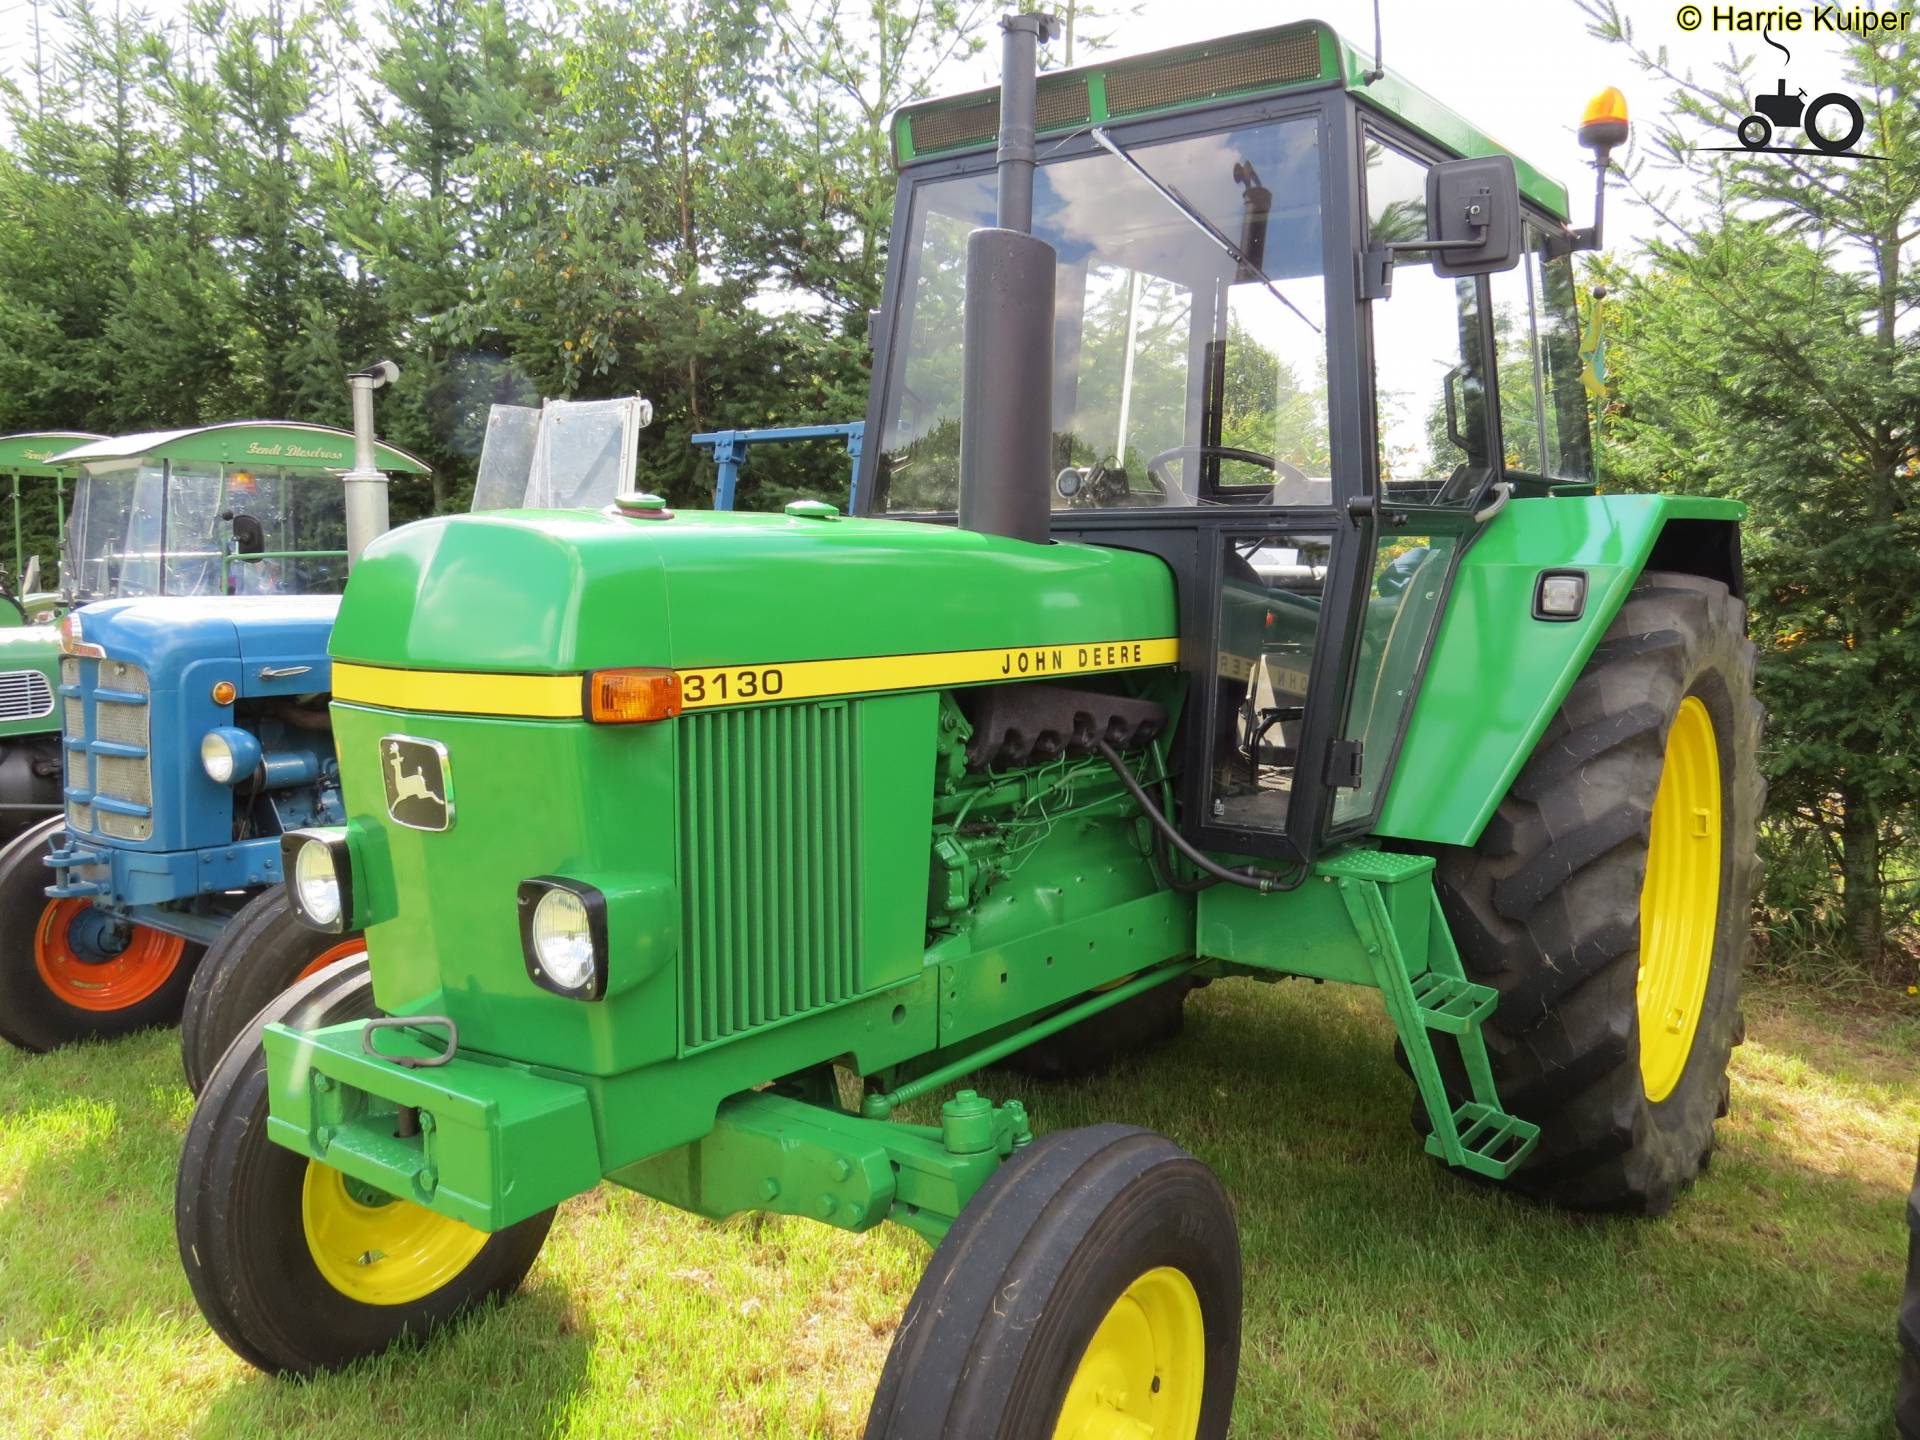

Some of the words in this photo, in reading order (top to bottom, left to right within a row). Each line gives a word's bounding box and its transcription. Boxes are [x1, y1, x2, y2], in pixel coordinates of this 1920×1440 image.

[246, 442, 282, 456] Fendt
[1002, 651, 1062, 674] JOHN
[1079, 645, 1142, 668] DEERE
[684, 669, 783, 702] 3130
